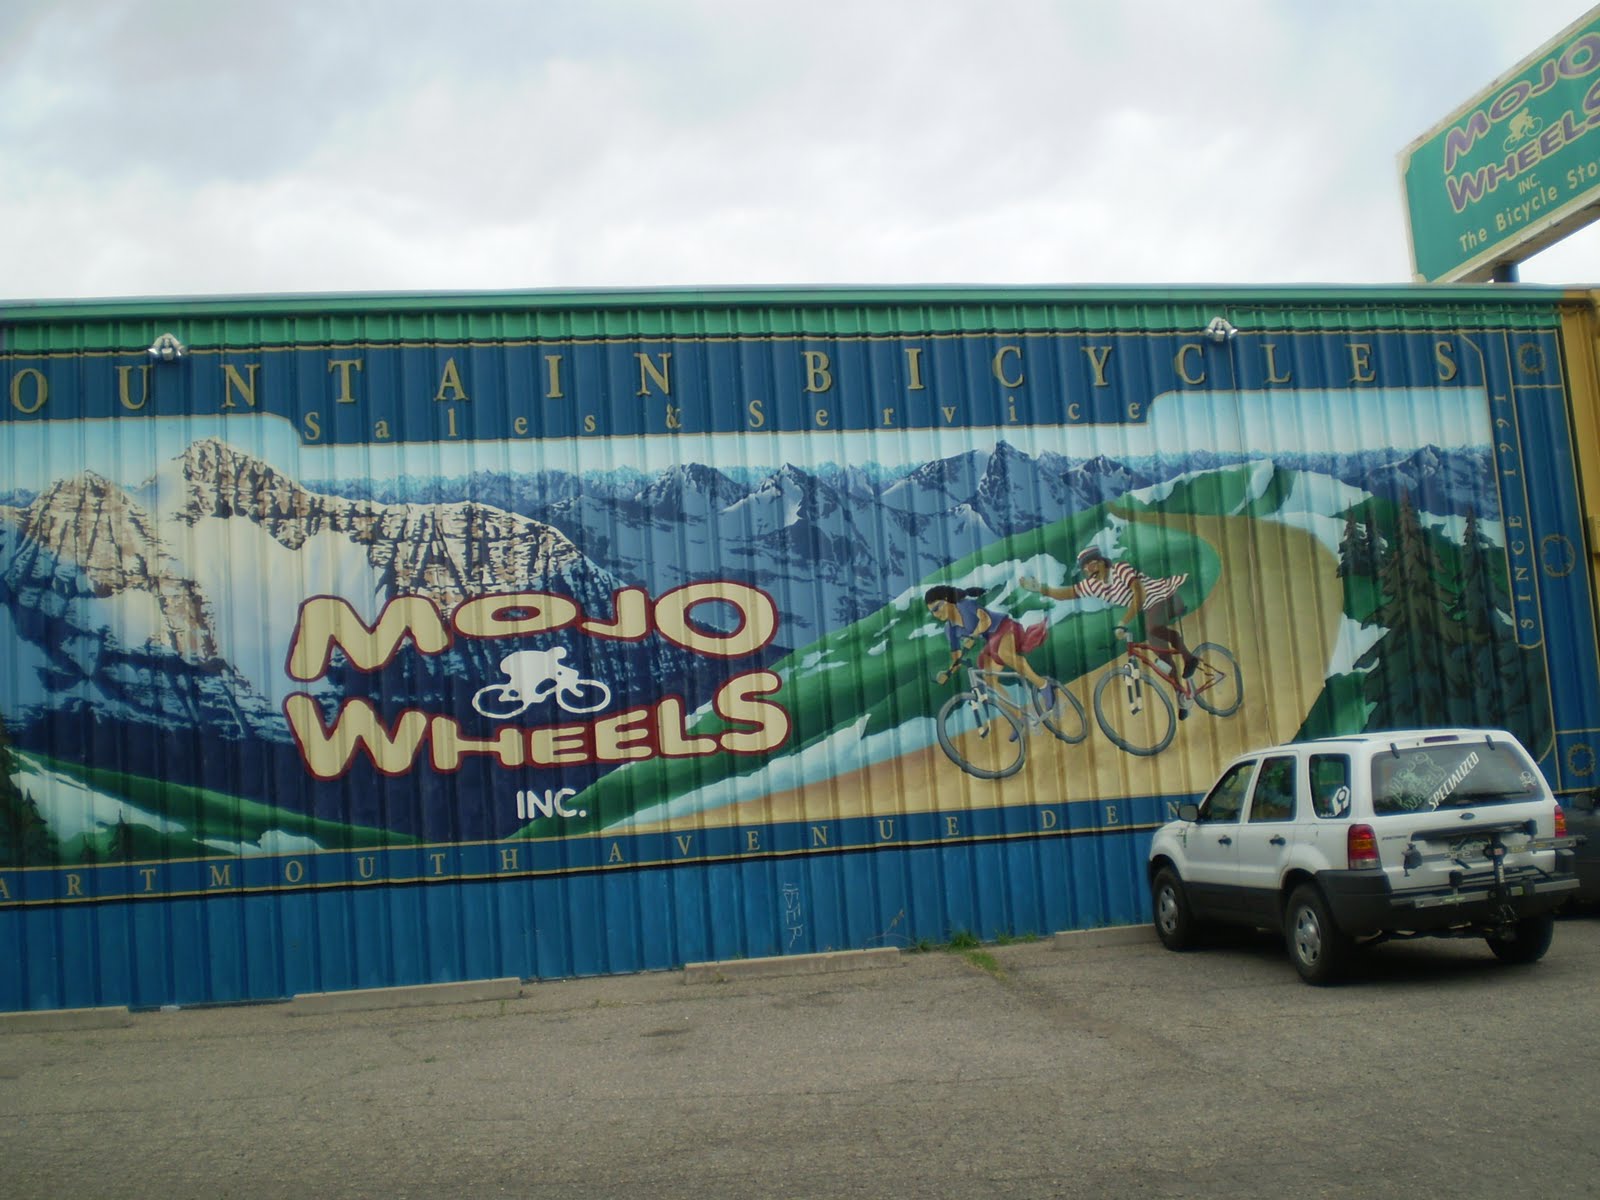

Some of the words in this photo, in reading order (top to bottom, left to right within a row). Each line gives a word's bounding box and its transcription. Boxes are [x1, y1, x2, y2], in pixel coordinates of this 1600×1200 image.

[1444, 32, 1600, 174] MOJO
[1460, 228, 1487, 252] The
[1495, 186, 1557, 231] Bicycle
[1567, 162, 1600, 189] Sto
[1518, 173, 1540, 195] INC.
[801, 341, 1458, 393] BICYCLES
[304, 407, 596, 441] Sales
[665, 403, 682, 429] &
[748, 396, 1140, 428] Service
[1494, 394, 1516, 476] 1991
[1508, 515, 1535, 629] SINCE
[285, 580, 777, 682] MOJO
[282, 670, 791, 781] WHEELS
[516, 788, 586, 819] INC.
[1428, 751, 1479, 812] SPECIALIZED
[608, 816, 959, 862] AVENUE
